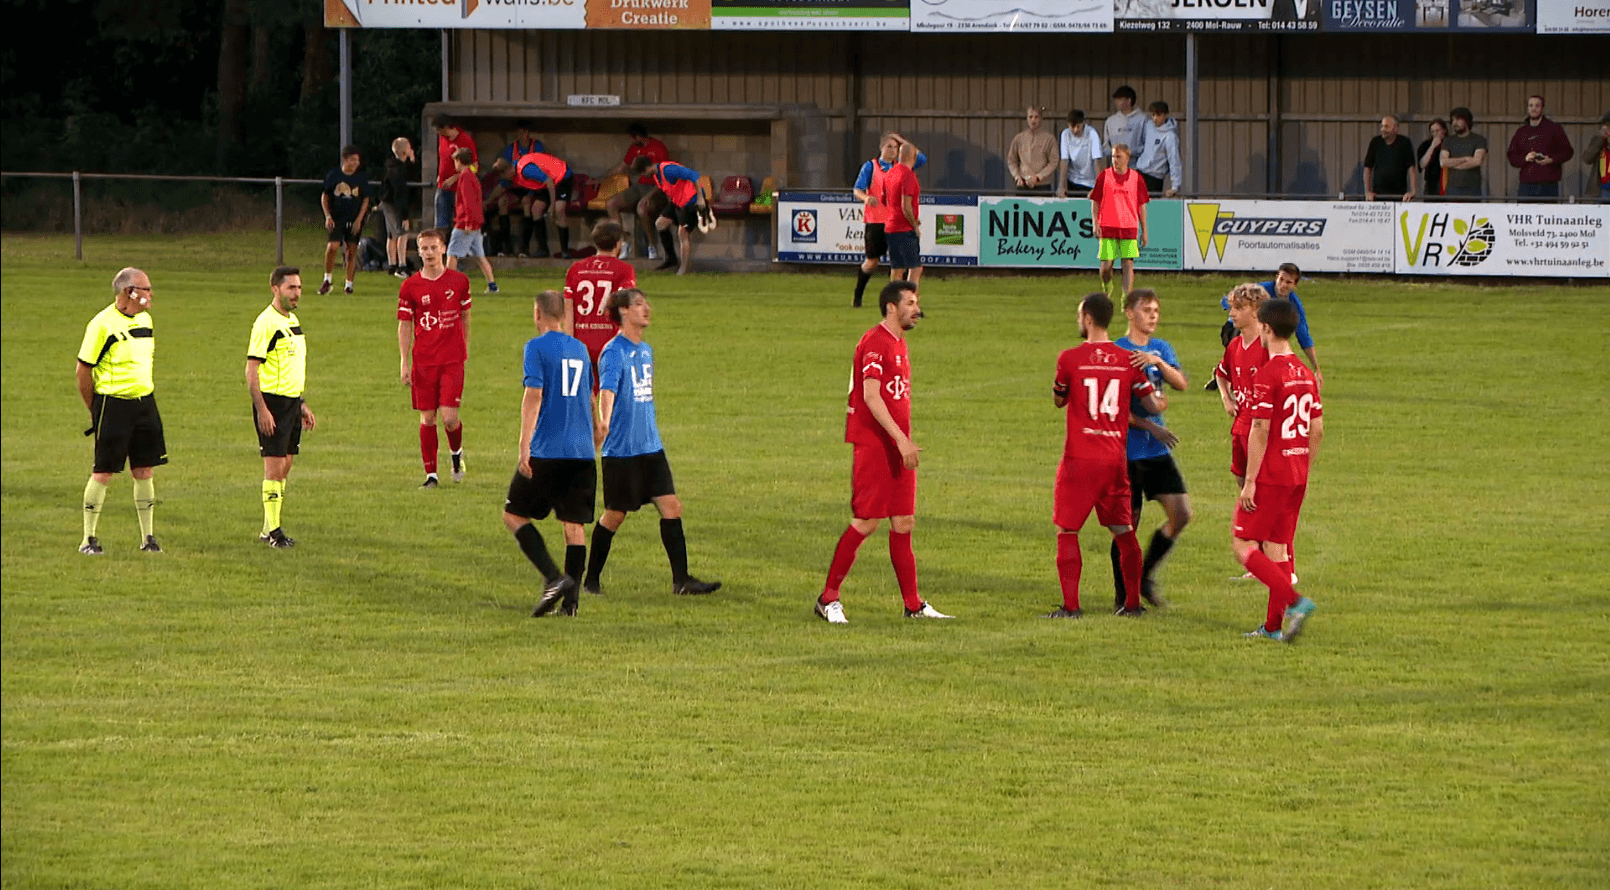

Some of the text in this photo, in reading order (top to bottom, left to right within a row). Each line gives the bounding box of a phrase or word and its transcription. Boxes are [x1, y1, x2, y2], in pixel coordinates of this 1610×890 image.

[1332, 1, 1397, 19] GEYSEN
[621, 11, 678, 25] Creatie
[1119, 21, 1156, 31] Kiezelweg
[1158, 21, 1170, 30] 132
[1186, 21, 1204, 30] 2400
[1271, 21, 1285, 30] 014
[1287, 21, 1297, 30] 43
[1298, 21, 1307, 30] 58
[1308, 21, 1318, 30] 59
[1217, 220, 1324, 235] CUYPERS
[1506, 214, 1603, 229] VHR Tuinaanleg
[1508, 228, 1545, 238] Molsveld
[1559, 231, 1578, 240] 2400
[1579, 229, 1596, 238] Mol
[997, 238, 1081, 261] Bakery Shop
[1238, 240, 1321, 252] Poortautomatisaties
[1515, 238, 1529, 247] Tel.
[1545, 241, 1559, 249] 494
[1560, 241, 1570, 249] 59
[1506, 257, 1605, 269] www.vhrtuinaanleg.be
[576, 279, 613, 316] 37
[561, 358, 584, 396] 17
[1083, 377, 1120, 422] 14
[1281, 393, 1313, 439] 29
